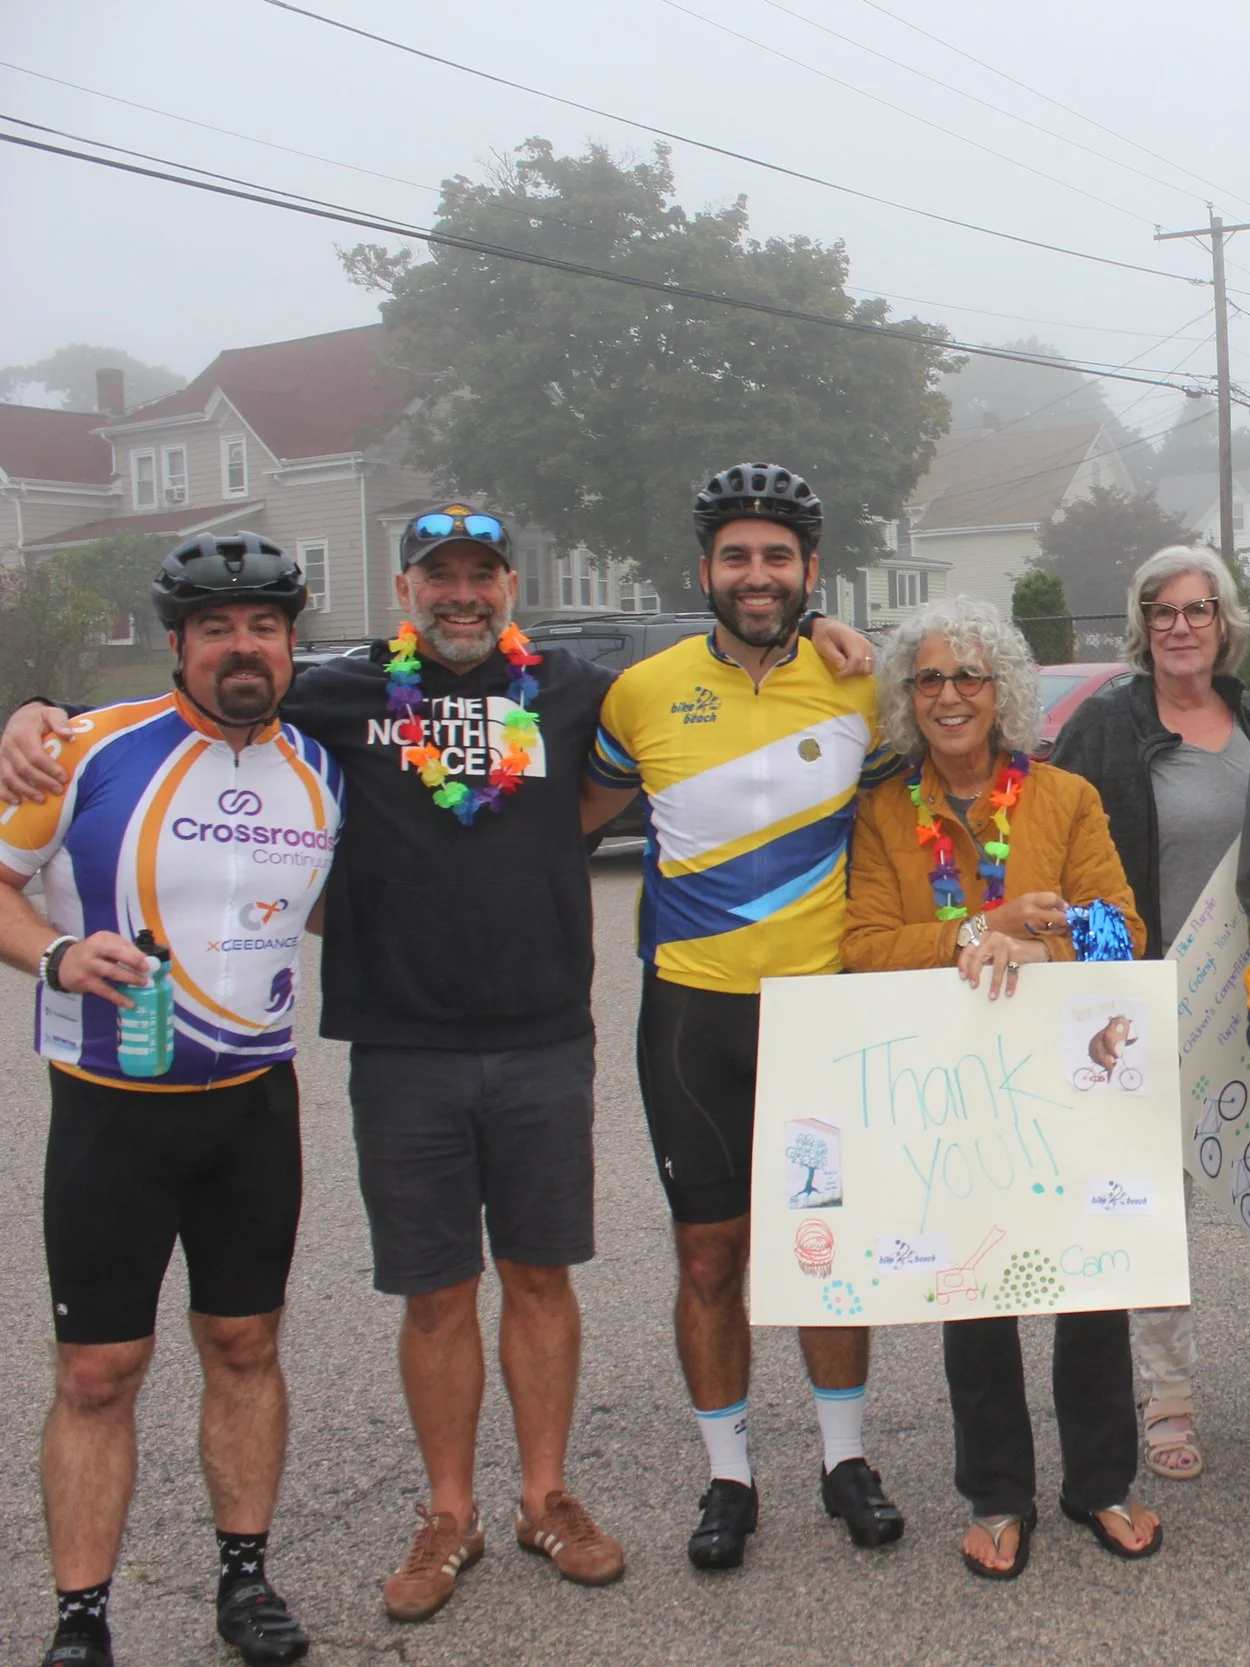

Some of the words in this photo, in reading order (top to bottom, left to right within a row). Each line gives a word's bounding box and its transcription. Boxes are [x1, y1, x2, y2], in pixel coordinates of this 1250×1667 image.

[671, 702, 695, 714] bike
[683, 712, 717, 725] beach
[401, 745, 487, 776] FCE
[172, 817, 335, 851] Crossroads
[206, 936, 299, 953] XCEEDANCE
[833, 1034, 1073, 1128] Thank
[1060, 1244, 1131, 1278] Cam
